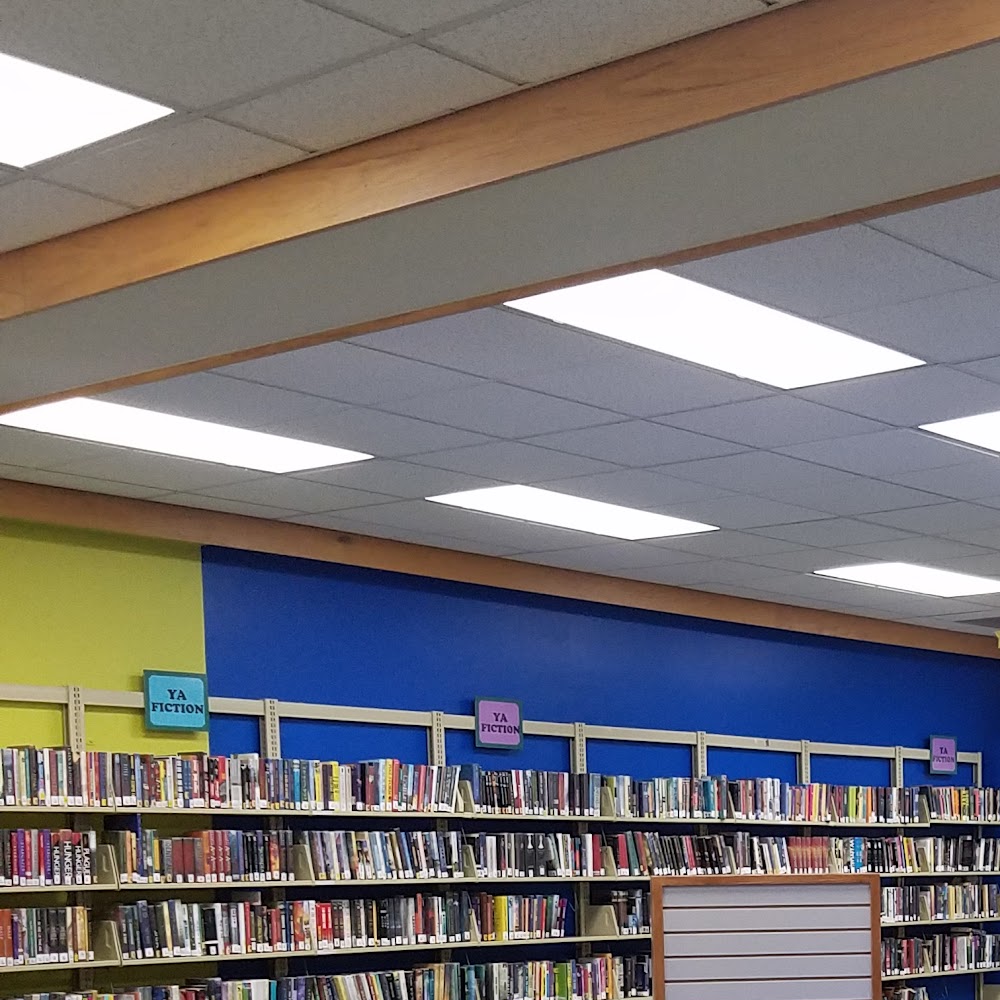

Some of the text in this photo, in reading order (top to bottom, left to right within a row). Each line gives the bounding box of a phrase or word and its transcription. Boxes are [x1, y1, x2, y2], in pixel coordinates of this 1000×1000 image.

[167, 689, 187, 701] YA
[151, 702, 204, 714] FICTION
[493, 712, 509, 723] YA
[481, 723, 521, 735] FICTION
